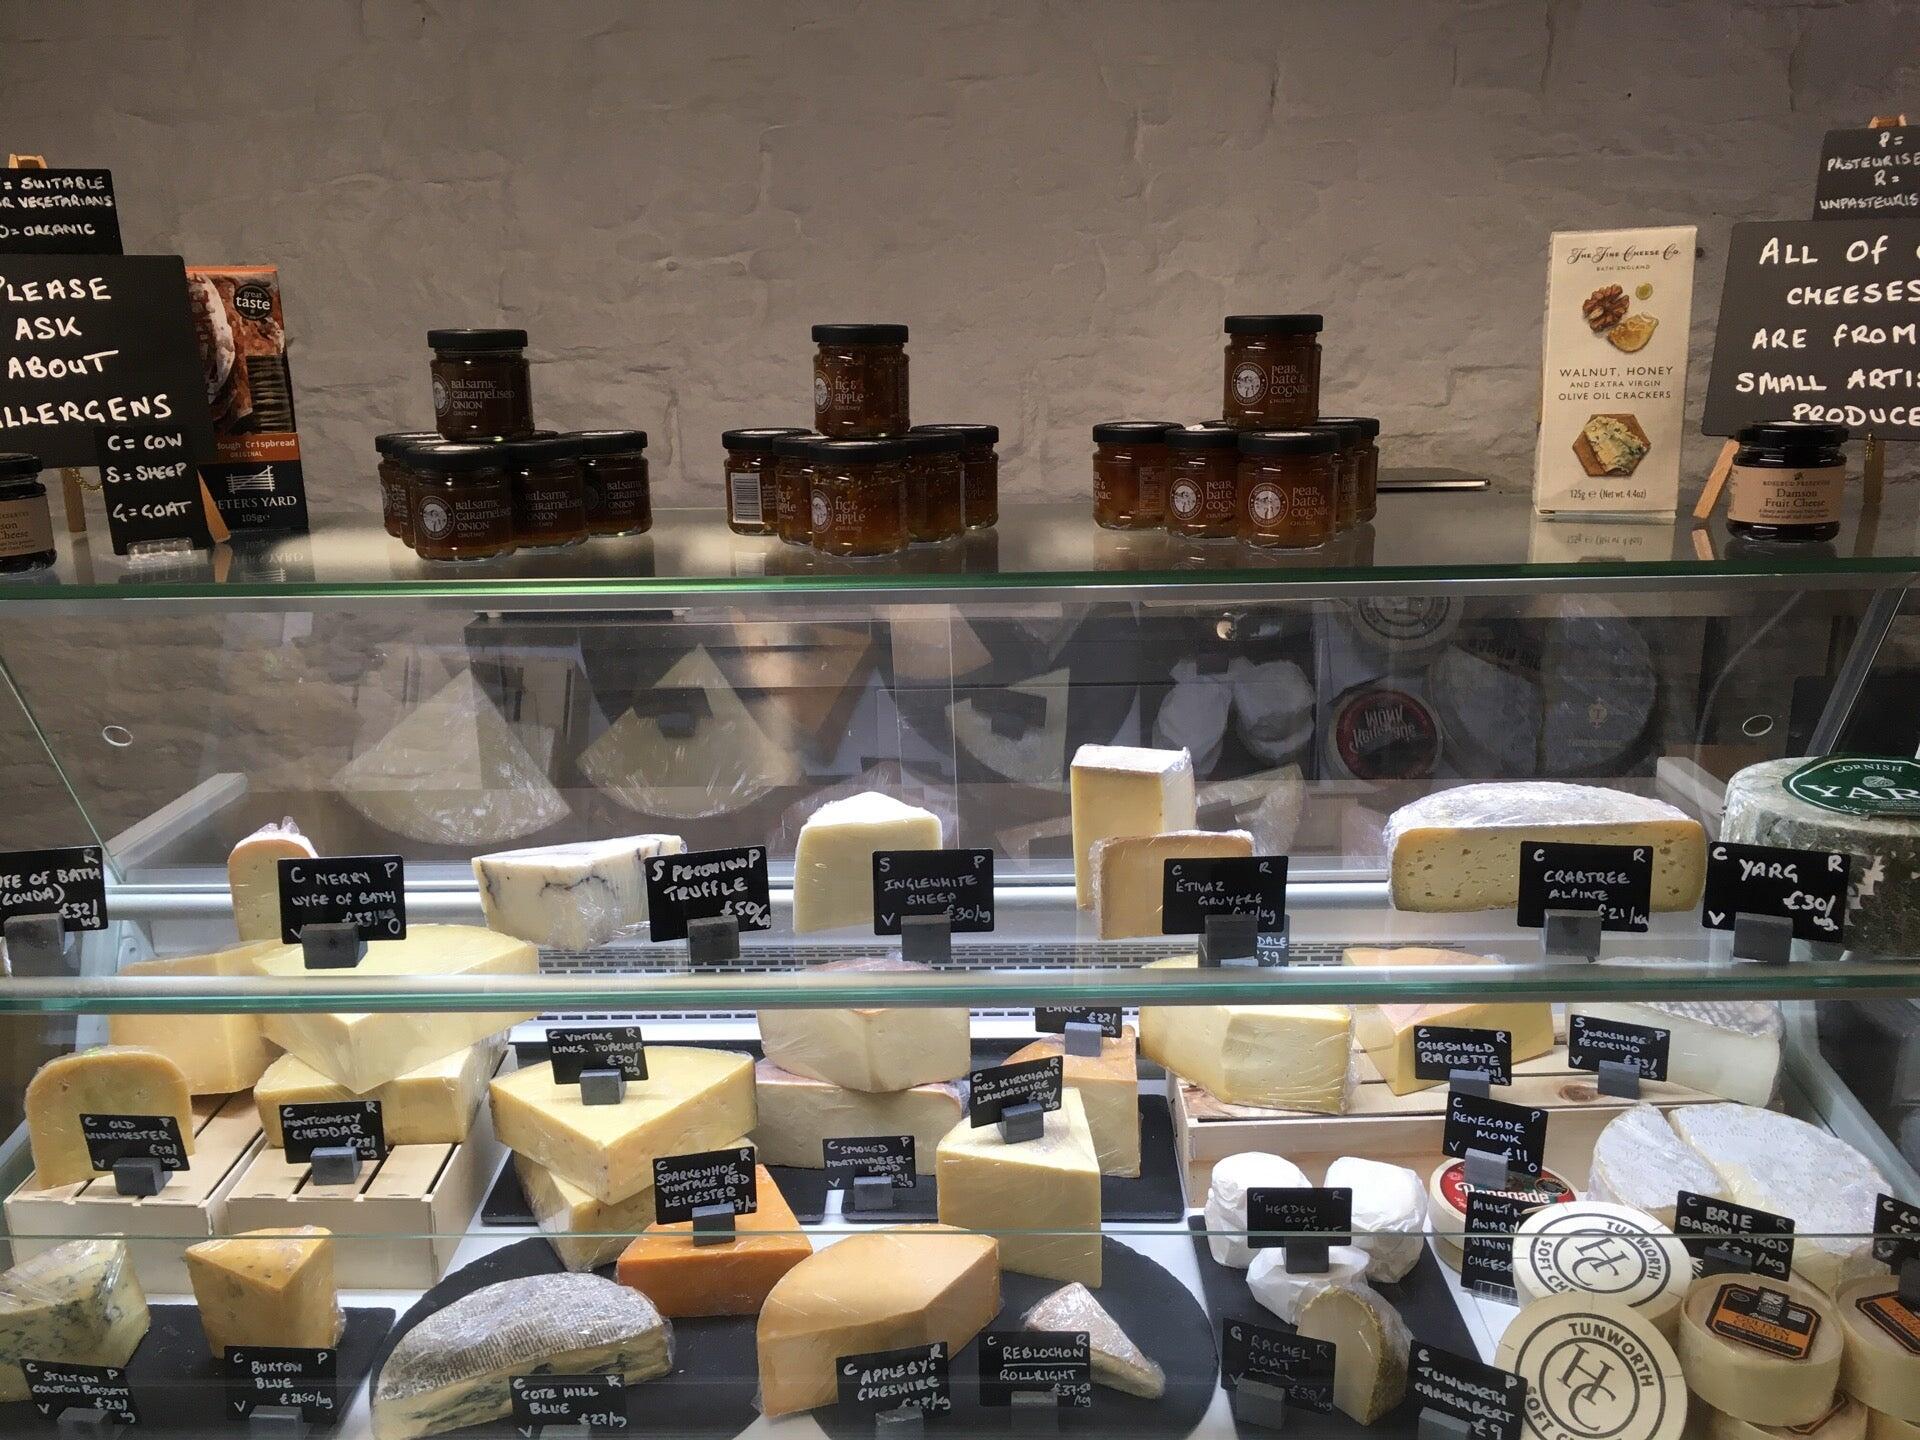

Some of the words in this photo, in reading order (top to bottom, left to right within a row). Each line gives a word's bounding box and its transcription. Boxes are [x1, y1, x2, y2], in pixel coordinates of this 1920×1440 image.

[21, 177, 104, 190] SUITABLE
[17, 194, 114, 209] VEGETARIANS
[23, 223, 96, 237] ORGANIC
[1759, 237, 1818, 265] ALL
[236, 296, 270, 310] taste
[15, 317, 83, 341] ASK
[1752, 328, 1807, 350] ARE
[1834, 324, 1915, 347] FROM
[8, 349, 119, 380] ABOUT
[1559, 367, 1620, 377] WALNUT,
[1626, 366, 1673, 376] HONEY
[1593, 380, 1624, 388] EXTRA
[1628, 379, 1661, 387] VIRGIN
[1736, 371, 1828, 394] SMALL
[1558, 392, 1589, 401] OLIVE
[1592, 391, 1611, 400] OIL
[1615, 390, 1672, 399] CRACKERS
[143, 433, 183, 449] COW
[245, 439, 296, 449] Crispbread
[136, 464, 187, 482] SHEEP
[1776, 488, 1818, 497] Damson
[261, 496, 297, 507] YARD
[1765, 498, 1790, 507] Fruit
[1793, 498, 1825, 508] Cheese
[140, 500, 192, 519] GOAT
[1833, 763, 1903, 774] CORNISH
[1533, 849, 1545, 862] C
[1633, 848, 1646, 863] R
[652, 860, 665, 881] S
[748, 849, 761, 868] P
[879, 857, 891, 872] S
[973, 856, 986, 869] P
[1172, 865, 1183, 876] C
[1259, 861, 1272, 873] R
[1712, 847, 1728, 860] C
[1739, 858, 1799, 883] YARG
[1828, 855, 1843, 872] R
[29, 870, 50, 886] OF
[57, 868, 101, 883] BATH
[291, 867, 305, 883] C
[384, 862, 398, 878] P
[1543, 870, 1630, 884] CRABTREE
[663, 877, 749, 901] TRUFFLE
[884, 874, 978, 892] INGLEWHITE
[336, 892, 353, 905] OF
[906, 892, 957, 905] SHEEP
[1198, 893, 1263, 906] GRUYERE
[1548, 888, 1609, 901] ALPINE
[881, 912, 895, 926] V
[1708, 910, 1725, 925] V
[548, 1031, 560, 1040] C
[564, 1032, 613, 1042] VINTAGE
[626, 1028, 637, 1038] R
[1418, 1028, 1430, 1038] C
[1496, 1031, 1507, 1043] R
[1574, 1017, 1585, 1028] S
[1655, 1030, 1667, 1041] P
[1581, 1028, 1647, 1045] YORKSHIRE
[1578, 1037, 1640, 1053] PECORINO
[1421, 1051, 1500, 1066] RACLETTE
[1571, 1055, 1583, 1065] V
[974, 1083, 996, 1094] MRS
[976, 1080, 1049, 1105] LANCASHIRE
[283, 1107, 295, 1117] C
[366, 1101, 377, 1113] R
[1453, 1097, 1463, 1108] C
[1531, 1111, 1541, 1122] P
[85, 1117, 97, 1126] C
[109, 1120, 136, 1129] OLD
[283, 1113, 360, 1128] MONTGOMERY
[1453, 1111, 1525, 1134] RENEGADE
[86, 1130, 172, 1141] WINCHESTER
[292, 1124, 364, 1139] CHEDDAR
[1476, 1130, 1521, 1144] MONK
[841, 1144, 888, 1155] SMOKED
[1449, 1141, 1460, 1152] V
[656, 1160, 668, 1171] C
[740, 1149, 750, 1161] R
[656, 1163, 738, 1186] SPARKENHOE
[868, 1164, 901, 1173] LAND
[661, 1176, 718, 1194] VINTAGE
[725, 1175, 750, 1185] RED
[665, 1186, 737, 1208] LEICESTER
[1332, 1190, 1342, 1201] R
[1284, 1215, 1318, 1223] GOAT
[1686, 1196, 1697, 1207] C
[1706, 1206, 1753, 1229] BRIE
[1536, 1239, 1553, 1270] SOFT
[1606, 1220, 1661, 1281] TUNWORTH
[987, 1336, 997, 1346] C
[1251, 1334, 1311, 1361] RACHEL
[233, 1352, 243, 1363] C
[317, 1352, 328, 1364] P
[1002, 1346, 1084, 1360] REBLOCHON
[1417, 1348, 1430, 1362] C
[1568, 1322, 1655, 1387] TUNWORTH
[251, 1360, 303, 1374] BUXTON
[1248, 1351, 1300, 1371] GOAT
[43, 1371, 99, 1384] STILTON
[999, 1369, 1077, 1381] ROLLRIGHT
[32, 1384, 80, 1394] COLSTON
[255, 1377, 294, 1389] BLUE
[513, 1378, 526, 1389] C
[857, 1375, 940, 1401] CHESHIRE
[1417, 1366, 1507, 1407] TUNWORTH
[521, 1388, 557, 1400] COTE
[563, 1386, 599, 1398] HILL
[233, 1400, 246, 1412] V
[529, 1402, 570, 1414] BLUE
